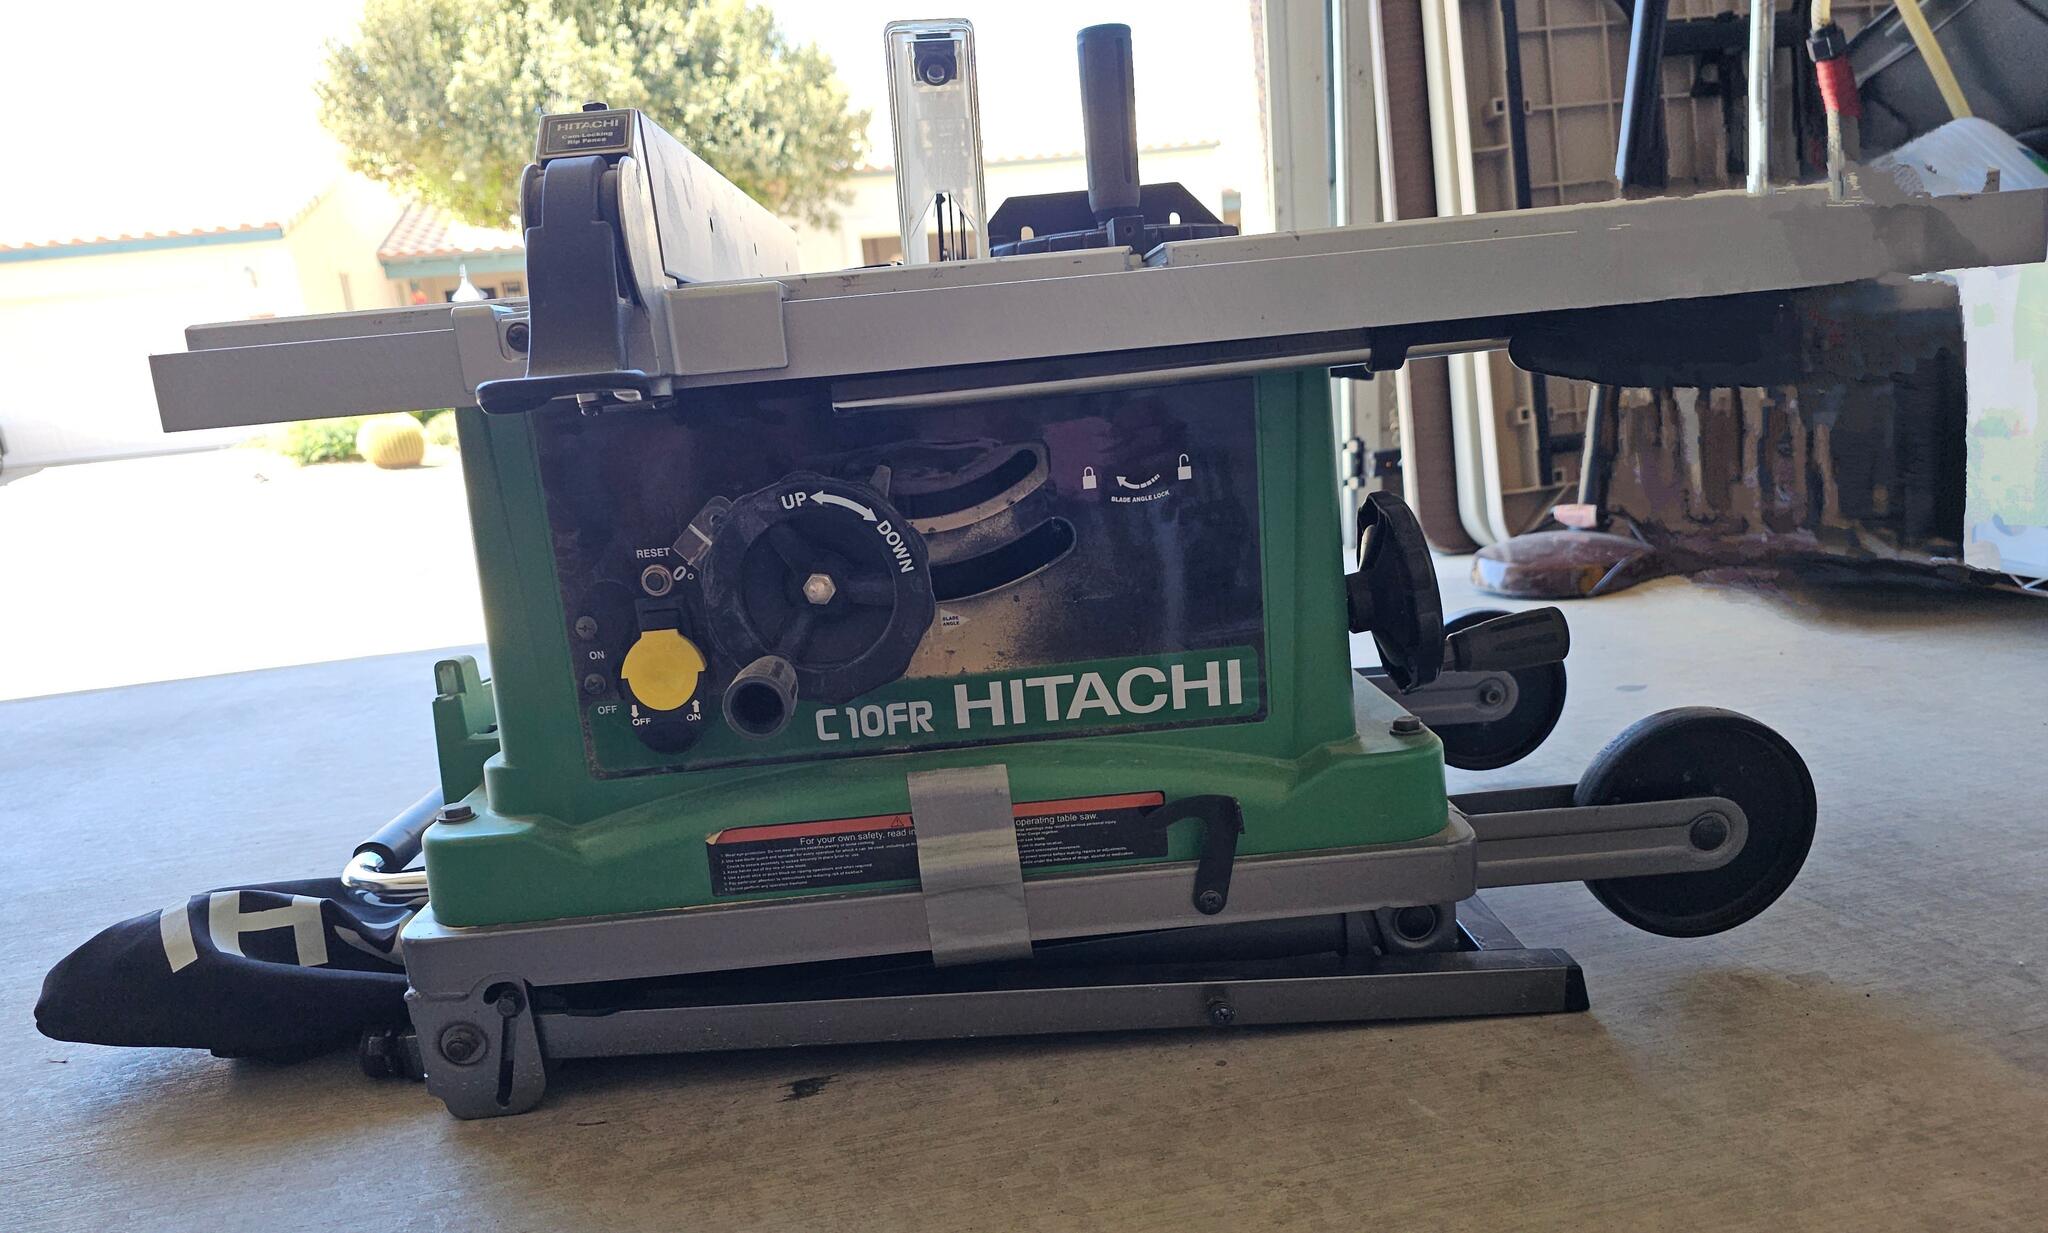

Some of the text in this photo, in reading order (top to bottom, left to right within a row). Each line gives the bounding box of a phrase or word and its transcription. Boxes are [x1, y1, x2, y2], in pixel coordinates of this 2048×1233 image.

[557, 119, 619, 131] HITACHI
[781, 491, 807, 510] UP
[1132, 495, 1153, 503] ANGLE
[1153, 490, 1170, 500] LOCK
[876, 520, 915, 573] DOWN
[636, 547, 670, 559] RESET
[589, 650, 605, 660] ON
[953, 659, 1243, 730] HITACHI
[597, 705, 617, 715] OFF
[632, 718, 651, 726] OFF
[686, 713, 701, 722] ON
[1015, 814, 1055, 827] operating
[1057, 814, 1078, 822] table
[800, 837, 814, 845] For
[817, 835, 836, 845] your
[838, 834, 856, 842] own
[887, 830, 907, 838] read
